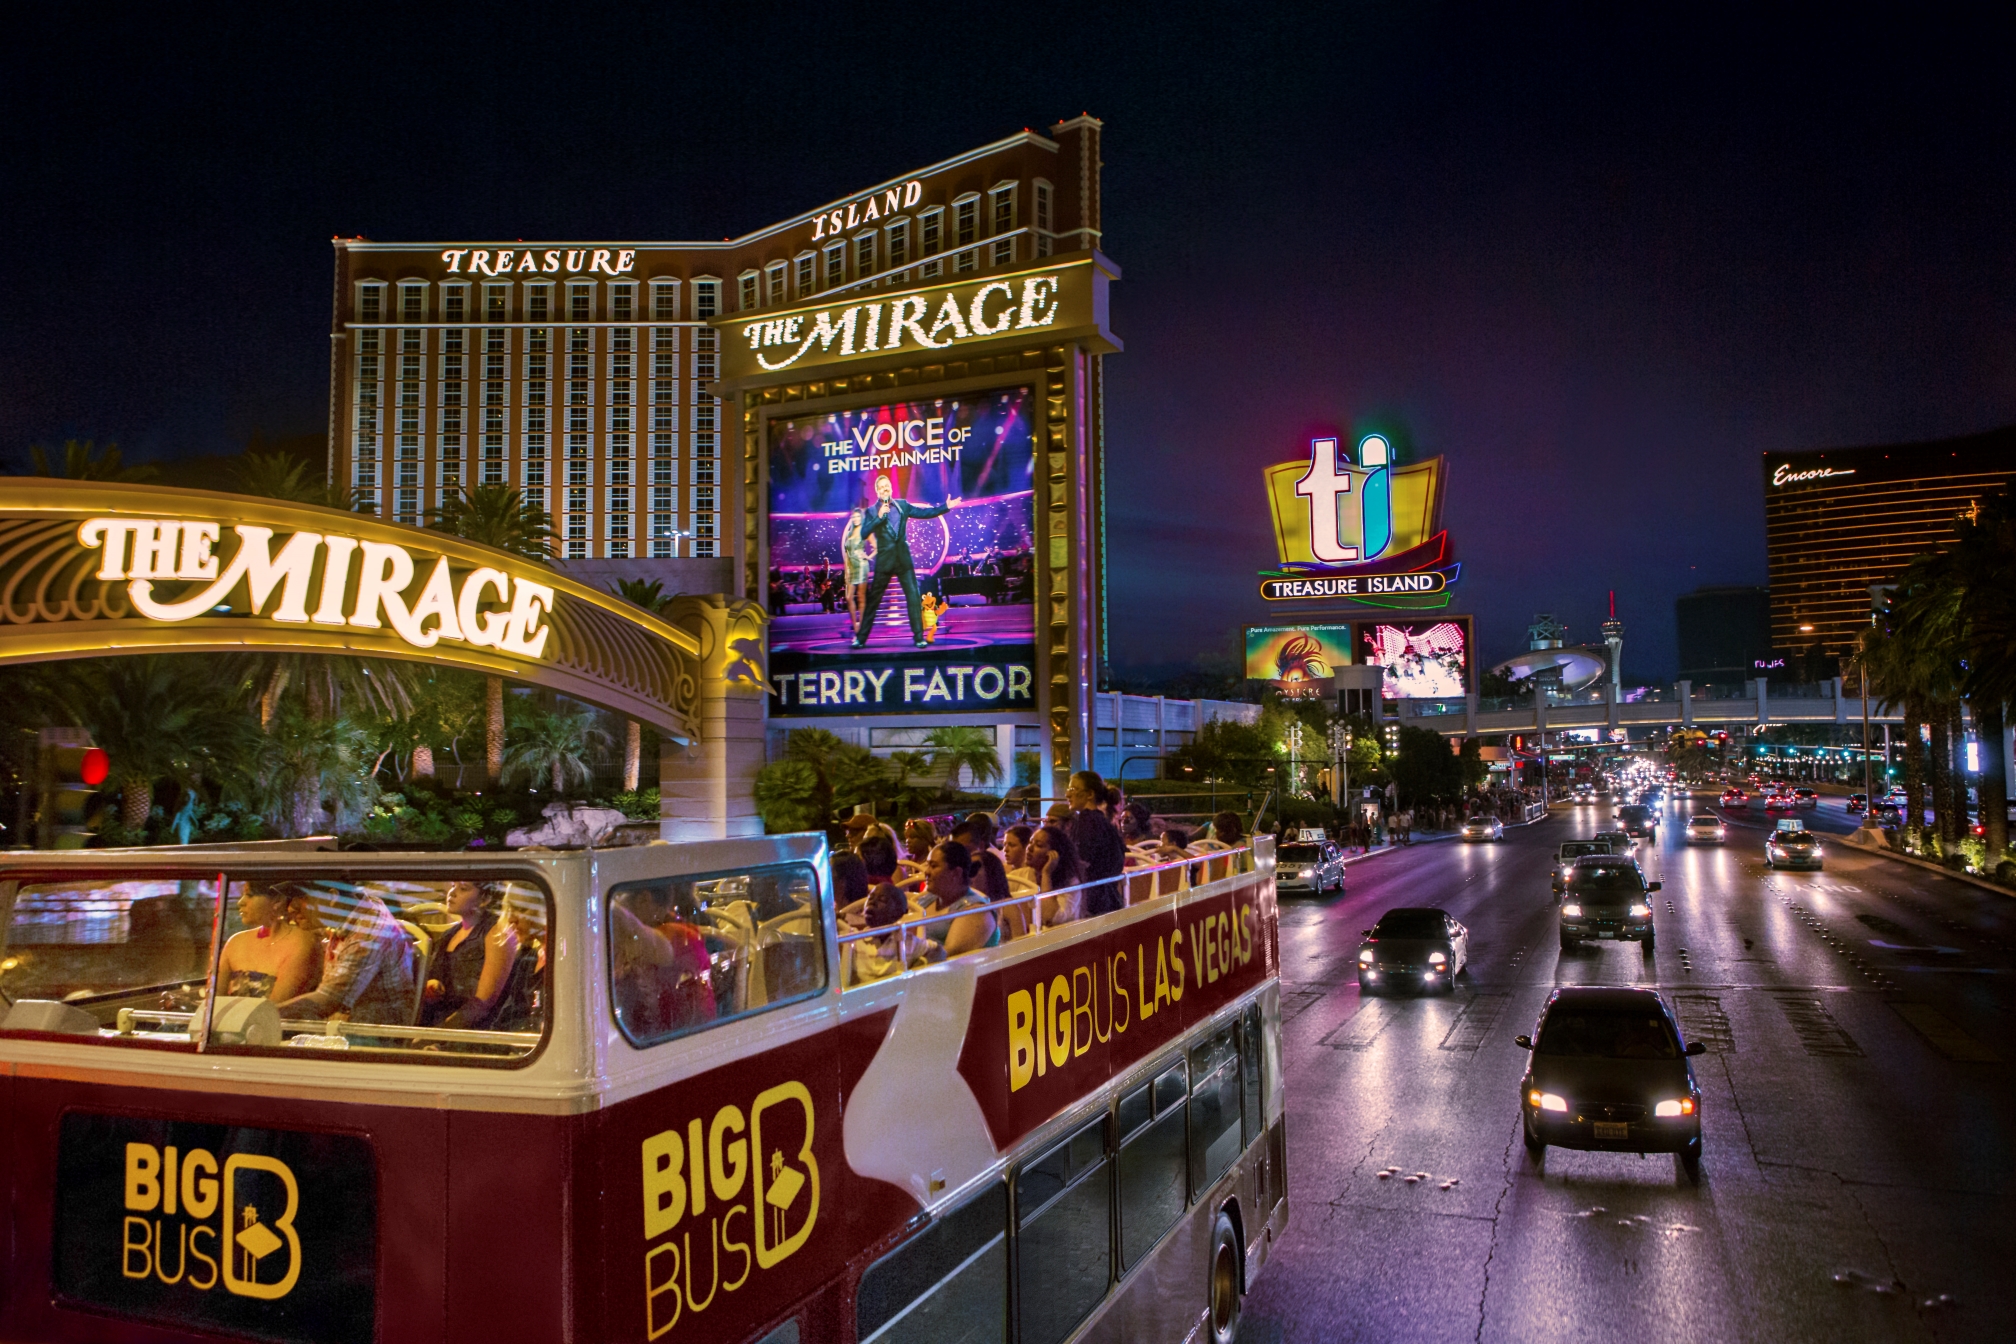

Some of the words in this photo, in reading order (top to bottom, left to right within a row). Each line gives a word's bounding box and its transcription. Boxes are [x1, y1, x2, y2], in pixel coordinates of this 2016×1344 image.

[811, 180, 923, 242] ISLAND
[441, 248, 637, 277] TREASURE
[743, 318, 802, 350] THE
[755, 276, 1059, 372] MIRAGE
[821, 438, 853, 457] THE
[851, 417, 945, 453] VOICE
[947, 427, 972, 443] OF
[827, 445, 964, 474] ENTERTAINMENT
[1772, 464, 1856, 486] Encore
[78, 518, 220, 580] THE
[128, 524, 555, 659] MIRAGE
[1272, 578, 1358, 597] TREASURE
[1367, 575, 1433, 593] ISLAND
[772, 669, 893, 705] TERRY
[903, 665, 1032, 702] FATOR
[1138, 928, 1186, 1021] LAS
[1188, 903, 1252, 989] VEGAS
[125, 1142, 220, 1220] BIG
[641, 1104, 749, 1241] BIG
[123, 1216, 219, 1291] BUS
[645, 1204, 752, 1343] BUS
